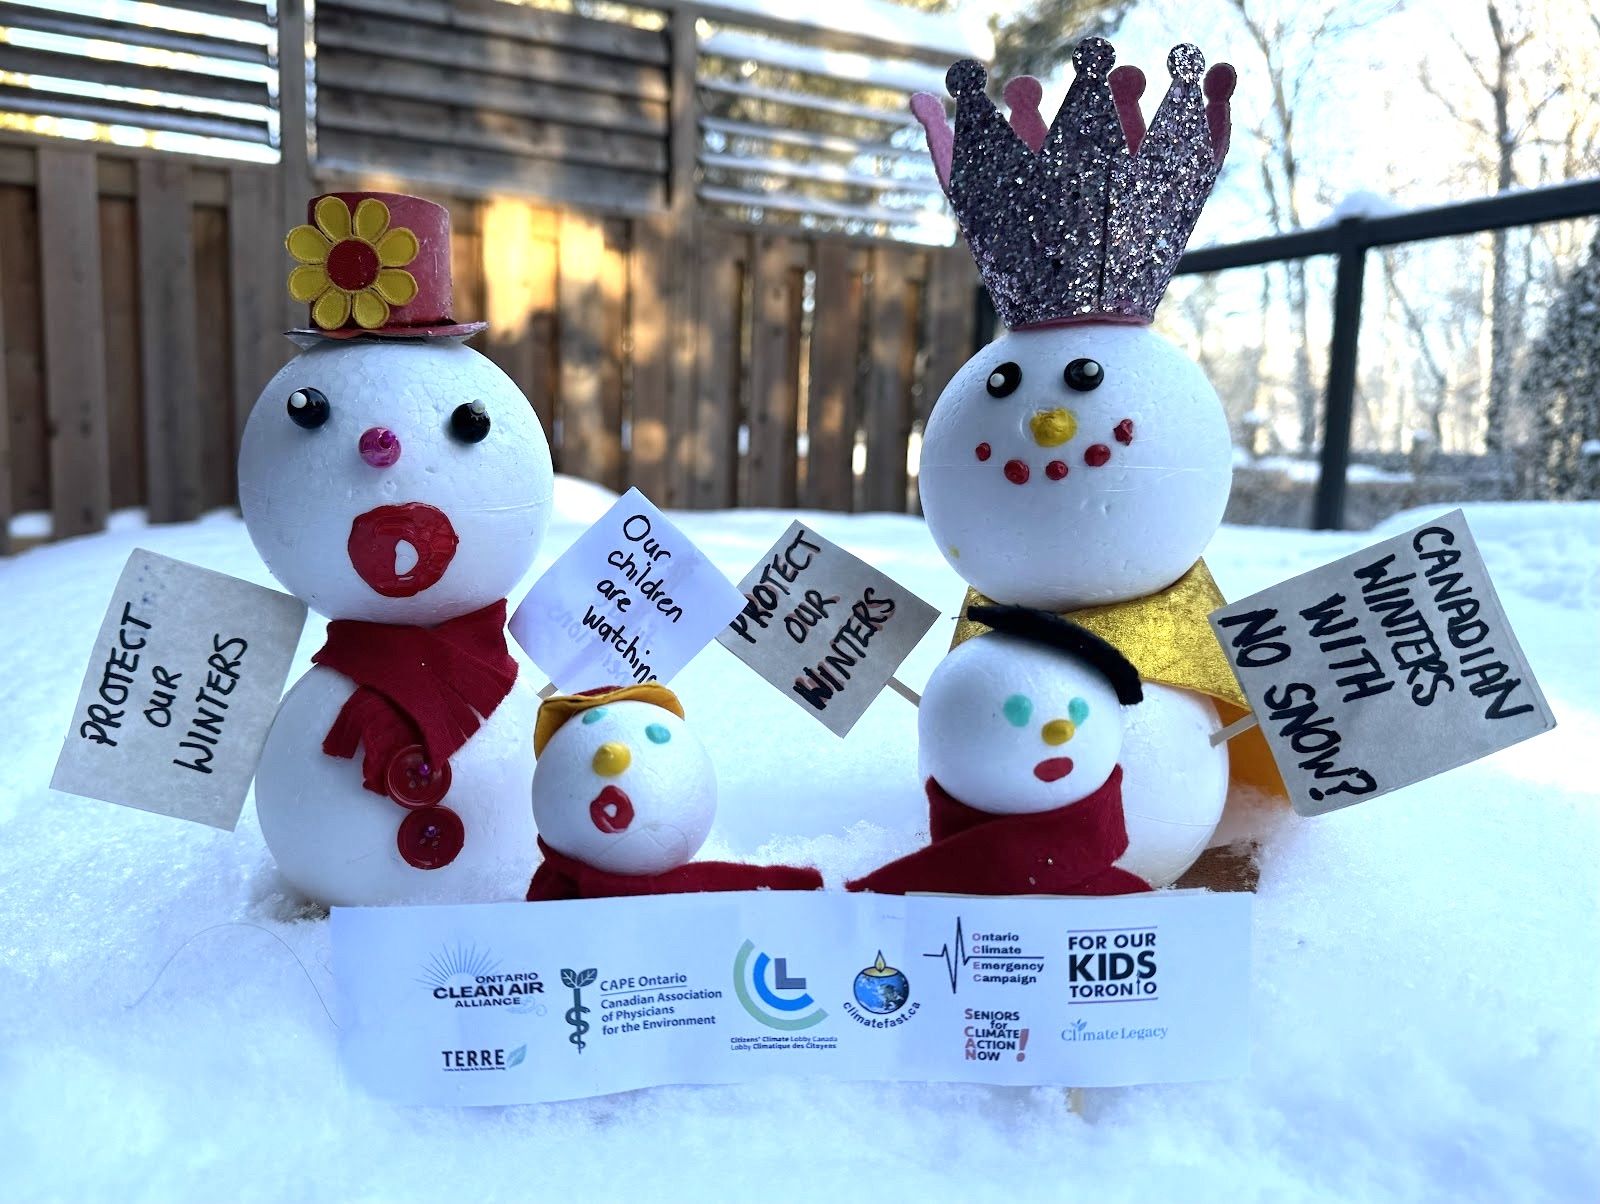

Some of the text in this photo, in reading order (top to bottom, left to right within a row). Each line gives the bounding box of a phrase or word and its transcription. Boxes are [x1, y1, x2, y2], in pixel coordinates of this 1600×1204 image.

[623, 514, 671, 562] Our
[596, 579, 631, 612] are
[784, 590, 840, 643] OUR
[1413, 526, 1534, 720] CANADIAN
[1354, 553, 1455, 706] WINTERS
[793, 587, 896, 710] WINTERS
[1298, 592, 1395, 703] WITH
[80, 601, 152, 746] PROTECT
[143, 665, 182, 727] OUR
[173, 633, 248, 774] WINTERS
[1217, 608, 1378, 801] NO SNOW?
[972, 932, 1019, 942] Ontario
[1068, 932, 1156, 950] FOR OUR
[972, 945, 1022, 955] Climate
[972, 960, 1044, 973] Emergency
[1068, 950, 1157, 983] KIDS
[475, 972, 539, 984] ONTARIO
[600, 973, 687, 992] CAPE Ontario
[972, 973, 1037, 985] Campaign
[433, 981, 545, 1000] CLEAN AIR
[601, 988, 722, 1009] Canadian Association
[454, 996, 521, 1008] ALLIANCE
[602, 1005, 675, 1022] of Physicians
[843, 1000, 921, 1029] climatefast.ca
[602, 1015, 716, 1036] for the Environment
[990, 1020, 1008, 1029] for
[1120, 1027, 1169, 1040] Legacy
[441, 1049, 505, 1067] TERRE
